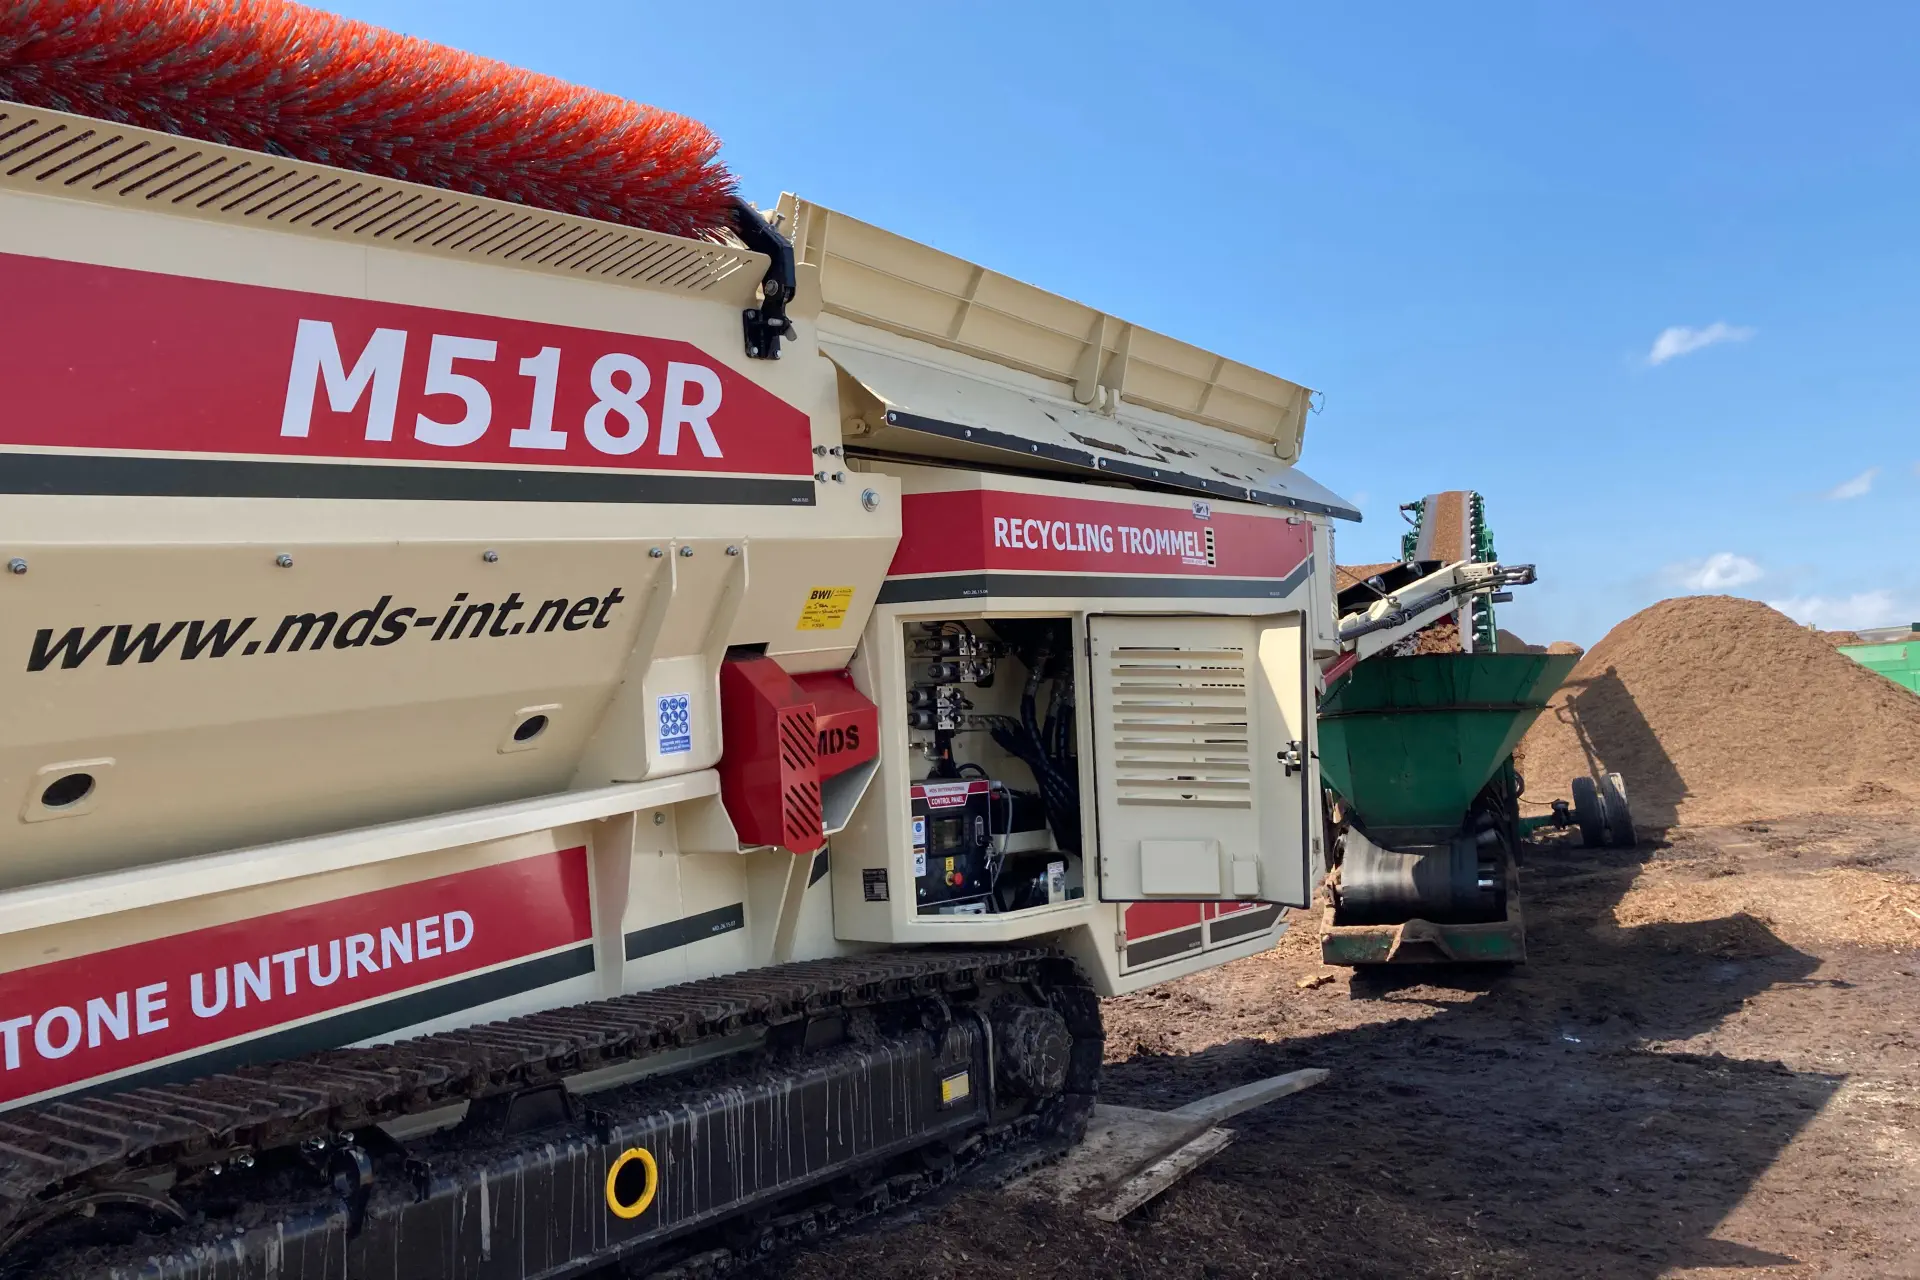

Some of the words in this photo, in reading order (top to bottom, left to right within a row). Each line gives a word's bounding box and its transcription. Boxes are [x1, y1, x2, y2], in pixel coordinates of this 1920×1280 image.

[280, 319, 723, 458] M518R
[993, 518, 1113, 552] RECYCLING
[1118, 526, 1204, 558] TROMMEL
[811, 589, 831, 600] BWI
[26, 588, 624, 671] www.mds-int.net
[931, 797, 951, 805] CONTROL
[951, 795, 964, 803] PANEL
[0, 982, 169, 1070] TONE
[190, 911, 474, 1017] UNTURNED
